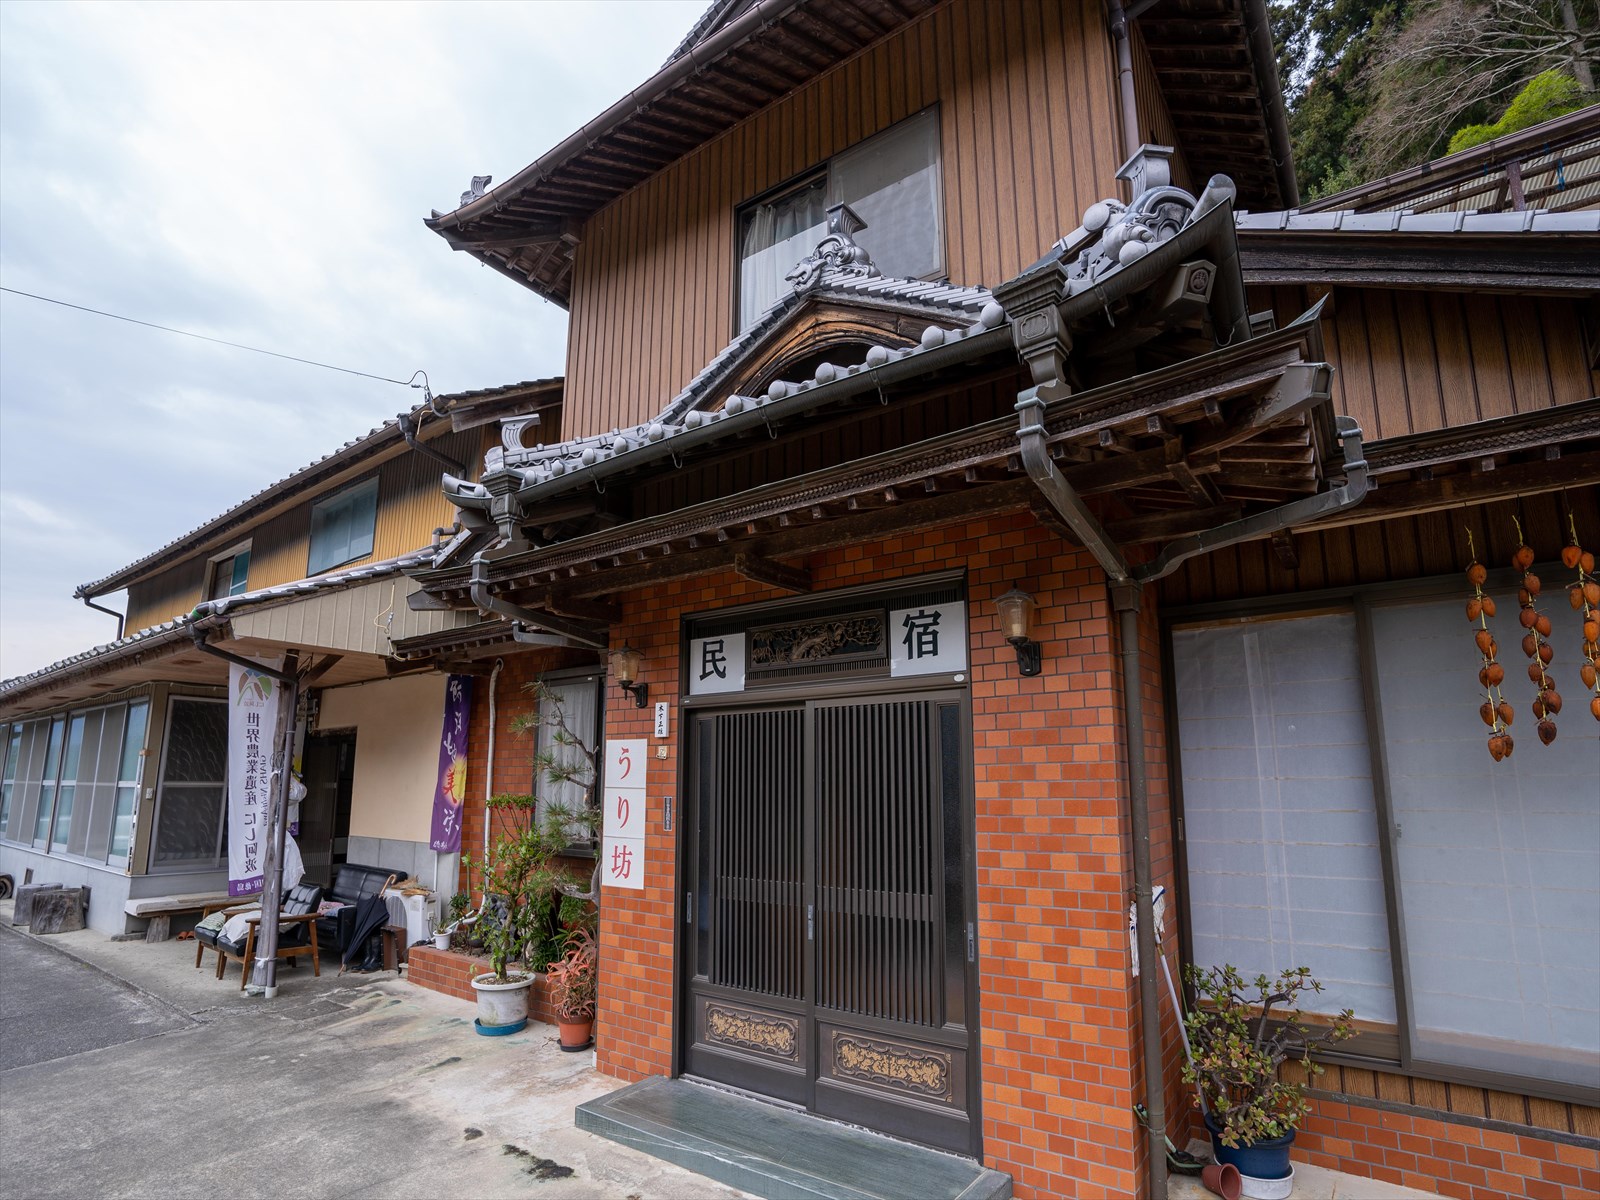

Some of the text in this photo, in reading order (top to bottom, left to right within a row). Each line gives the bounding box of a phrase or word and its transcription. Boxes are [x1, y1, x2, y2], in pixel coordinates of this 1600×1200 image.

[699, 609, 942, 681] 民 宿
[611, 746, 633, 880] うり坊
